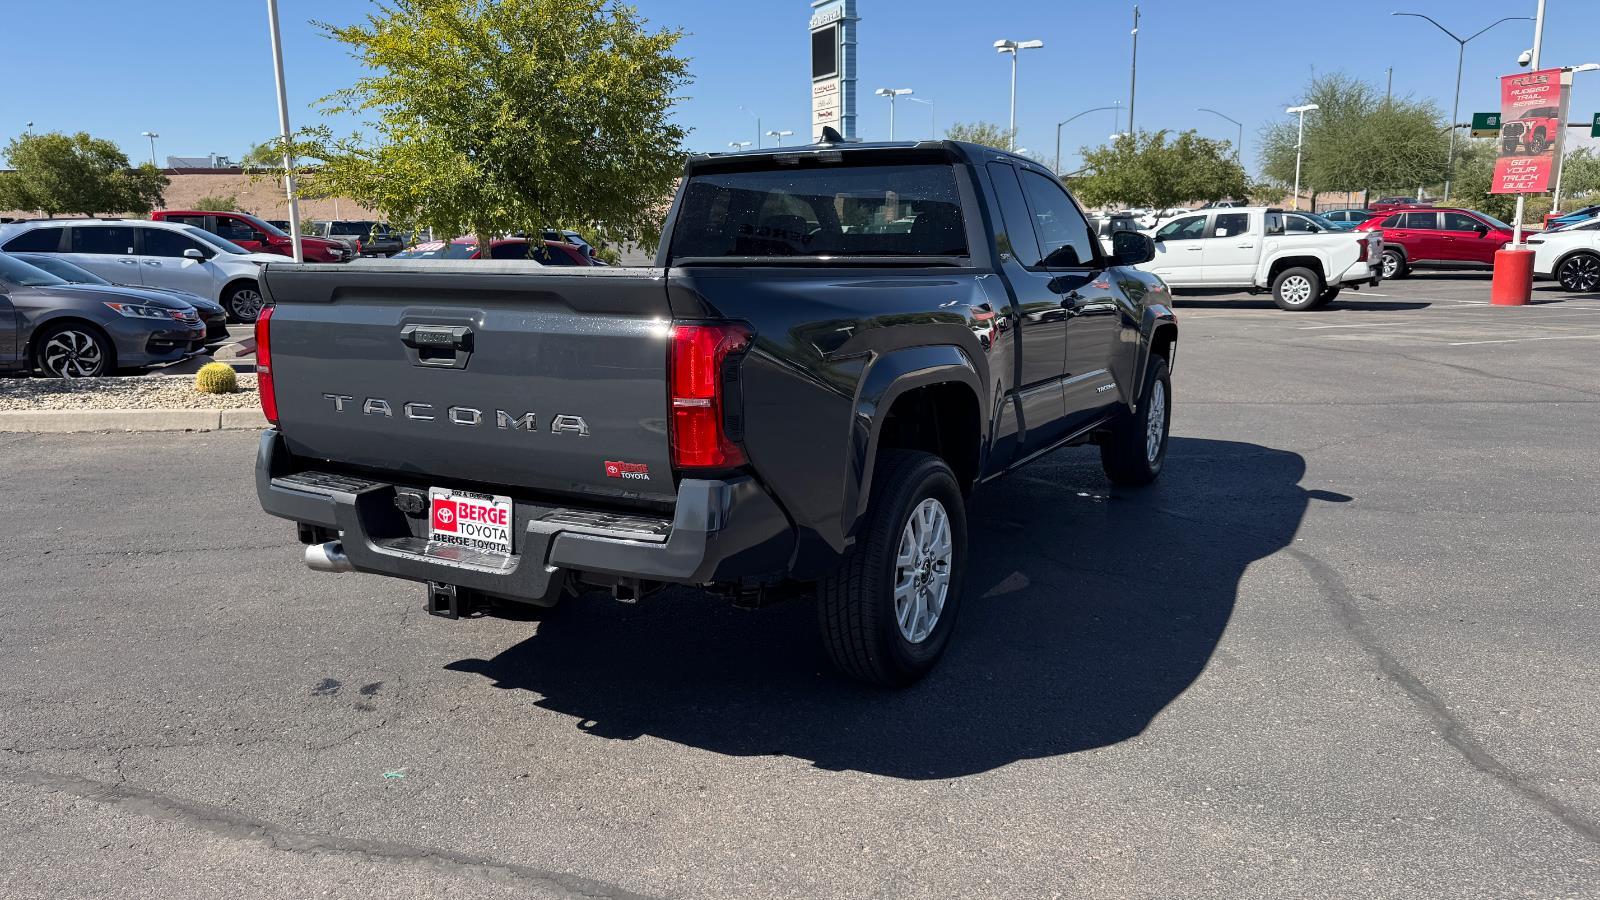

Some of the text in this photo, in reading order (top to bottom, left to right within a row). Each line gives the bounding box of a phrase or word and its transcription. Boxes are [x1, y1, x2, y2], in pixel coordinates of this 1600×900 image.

[1516, 93, 1541, 101] TRAIL
[1510, 158, 1534, 166] GET
[1506, 166, 1537, 174] YOUR
[1502, 173, 1540, 182] TRUCK
[416, 331, 453, 344] TOYOTA
[322, 392, 591, 437] TACOMA
[621, 472, 650, 481] TOYOTA
[458, 502, 508, 526] BERGE
[459, 522, 508, 541] TOYOTA
[433, 532, 507, 553] BERGE TOYOTA
